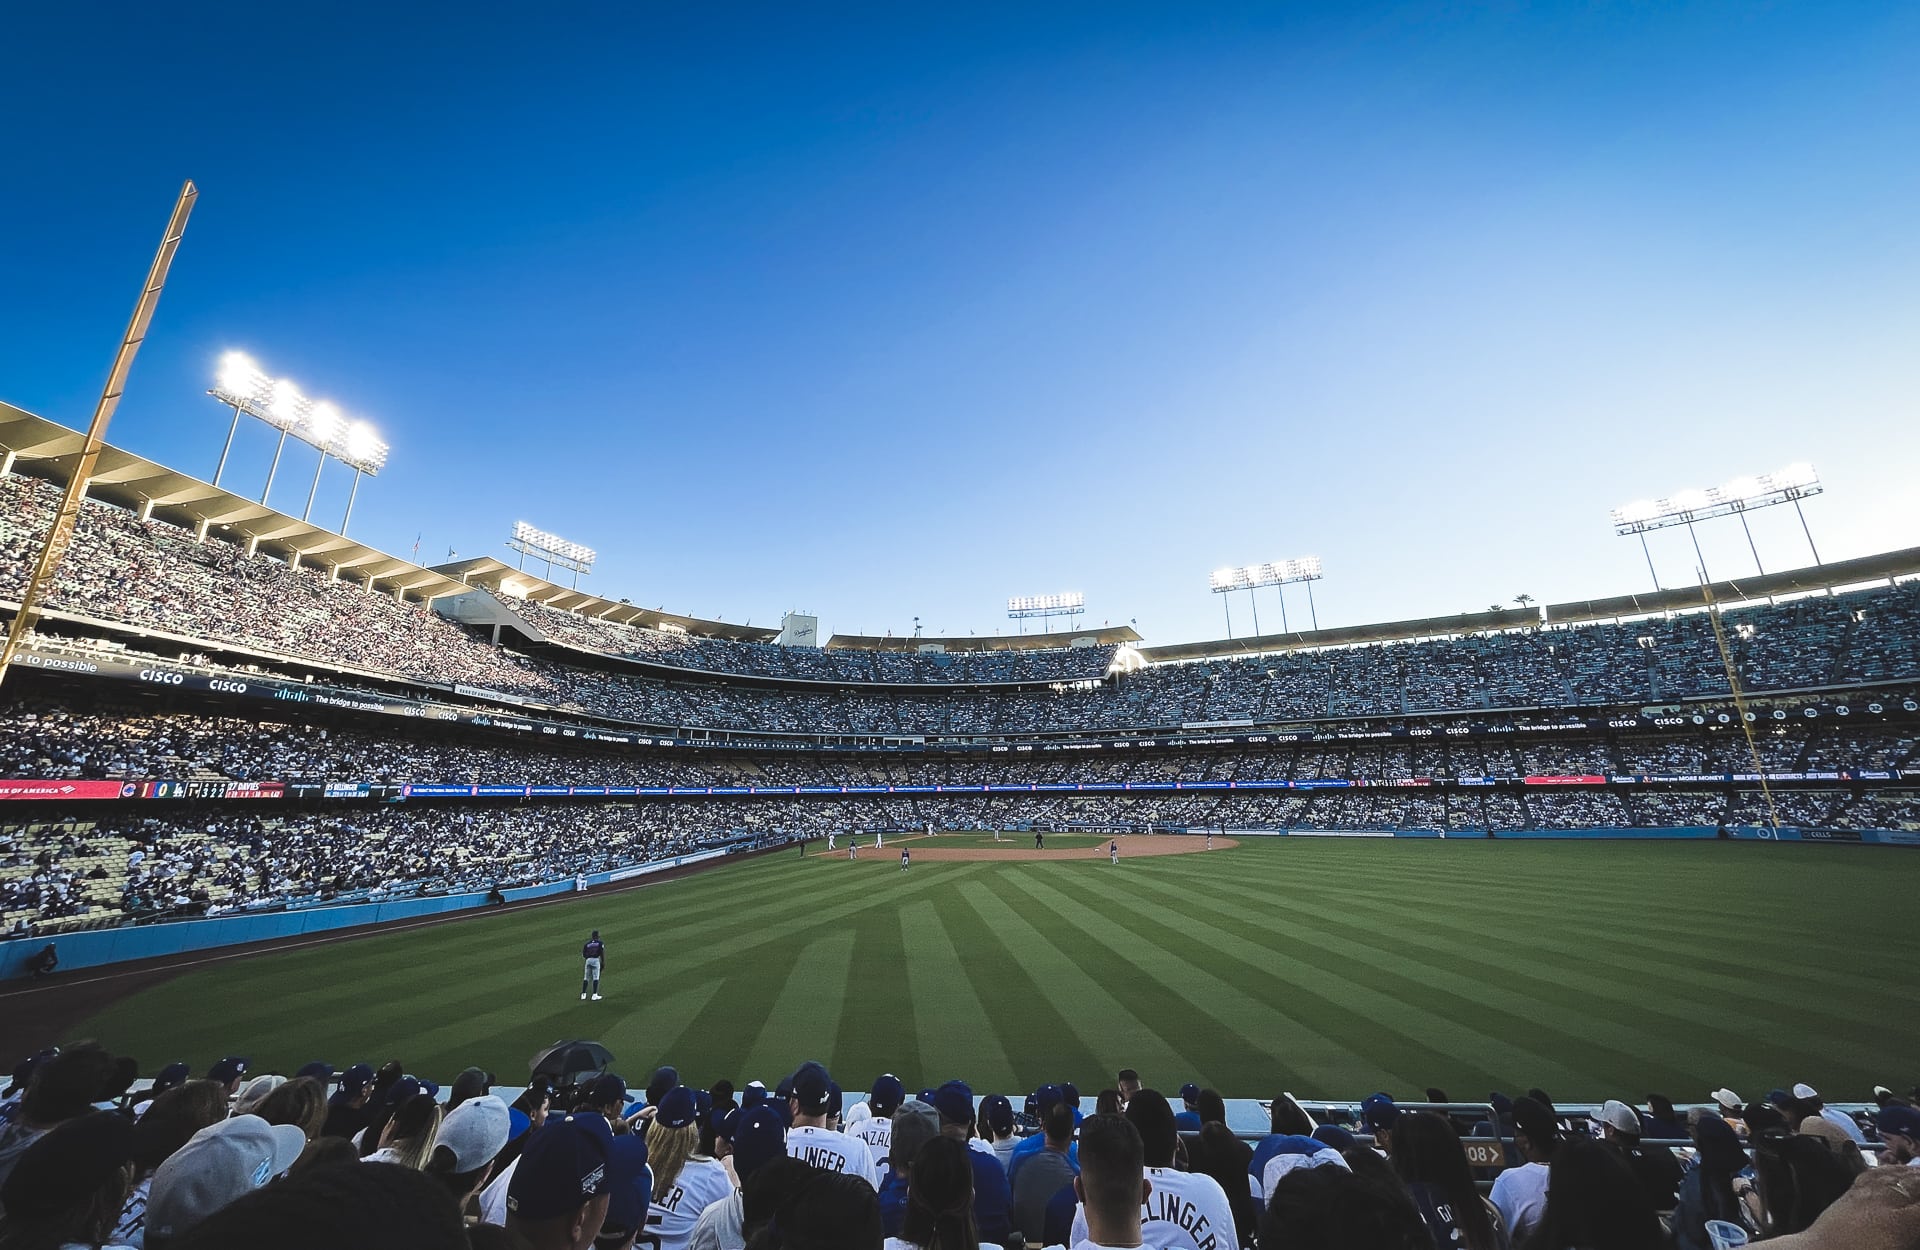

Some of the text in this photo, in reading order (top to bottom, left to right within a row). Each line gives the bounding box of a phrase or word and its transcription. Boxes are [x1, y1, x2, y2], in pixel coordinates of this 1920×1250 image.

[27, 654, 40, 664] to
[43, 658, 98, 672] possible
[140, 669, 184, 684] CISCO
[209, 680, 247, 694] CISCO
[315, 694, 385, 711] The bridge to possible
[404, 706, 426, 716] CISCO
[438, 712, 458, 721] CISCO
[1608, 720, 1636, 728] CISCO
[1654, 717, 1684, 725] CISCO
[542, 726, 556, 734] CISCO
[158, 783, 168, 796] 0
[210, 788, 216, 798] 2
[218, 788, 224, 798] 2
[1141, 1192, 1216, 1250] LINGER
